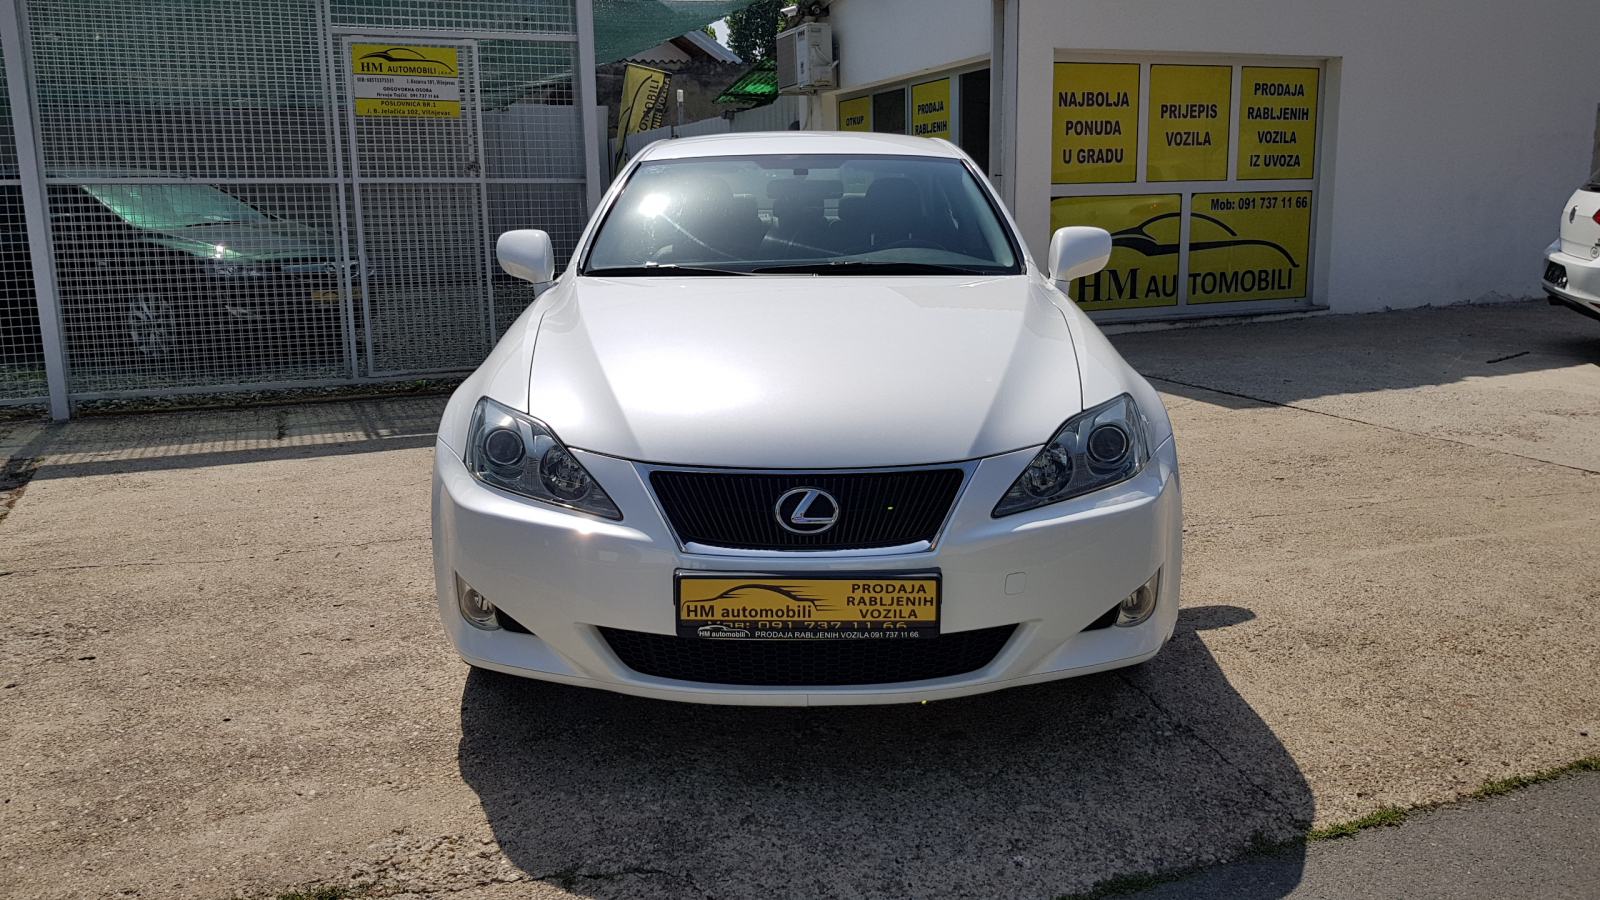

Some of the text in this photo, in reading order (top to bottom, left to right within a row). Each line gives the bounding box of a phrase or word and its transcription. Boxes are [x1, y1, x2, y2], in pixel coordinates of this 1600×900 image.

[361, 62, 383, 73] HM
[387, 66, 437, 74] AUTOMOBILI
[1253, 82, 1305, 97] PRODAJA
[380, 100, 421, 108] POSLOVNICA
[1058, 91, 1130, 108] NAJBOLJA
[917, 101, 944, 116] PRODAJA
[1160, 103, 1218, 119] PRIJEPIS
[1247, 106, 1309, 121] RABLJENIH
[845, 115, 865, 127] OTKUP
[914, 120, 948, 137] RABLJENIH
[1065, 120, 1122, 136] PONUDA
[1165, 131, 1212, 147] VOZILA
[1257, 130, 1297, 145] VOZILA
[1062, 148, 1124, 164] U GRADU
[1249, 154, 1301, 168] IZ UVOZA
[1210, 195, 1308, 211] Mob: 091 737 11 66
[1077, 267, 1293, 303] HM AUTOMOBILI
[851, 583, 927, 594] PRODAJA
[846, 596, 934, 607] RABLJENIH
[686, 604, 812, 619] HM automobili
[859, 608, 918, 619] VOZILA
[699, 630, 746, 639] HM automobili
[755, 631, 919, 639] PRODAJA RABLJENIH VOZILA 091 737 11 66
